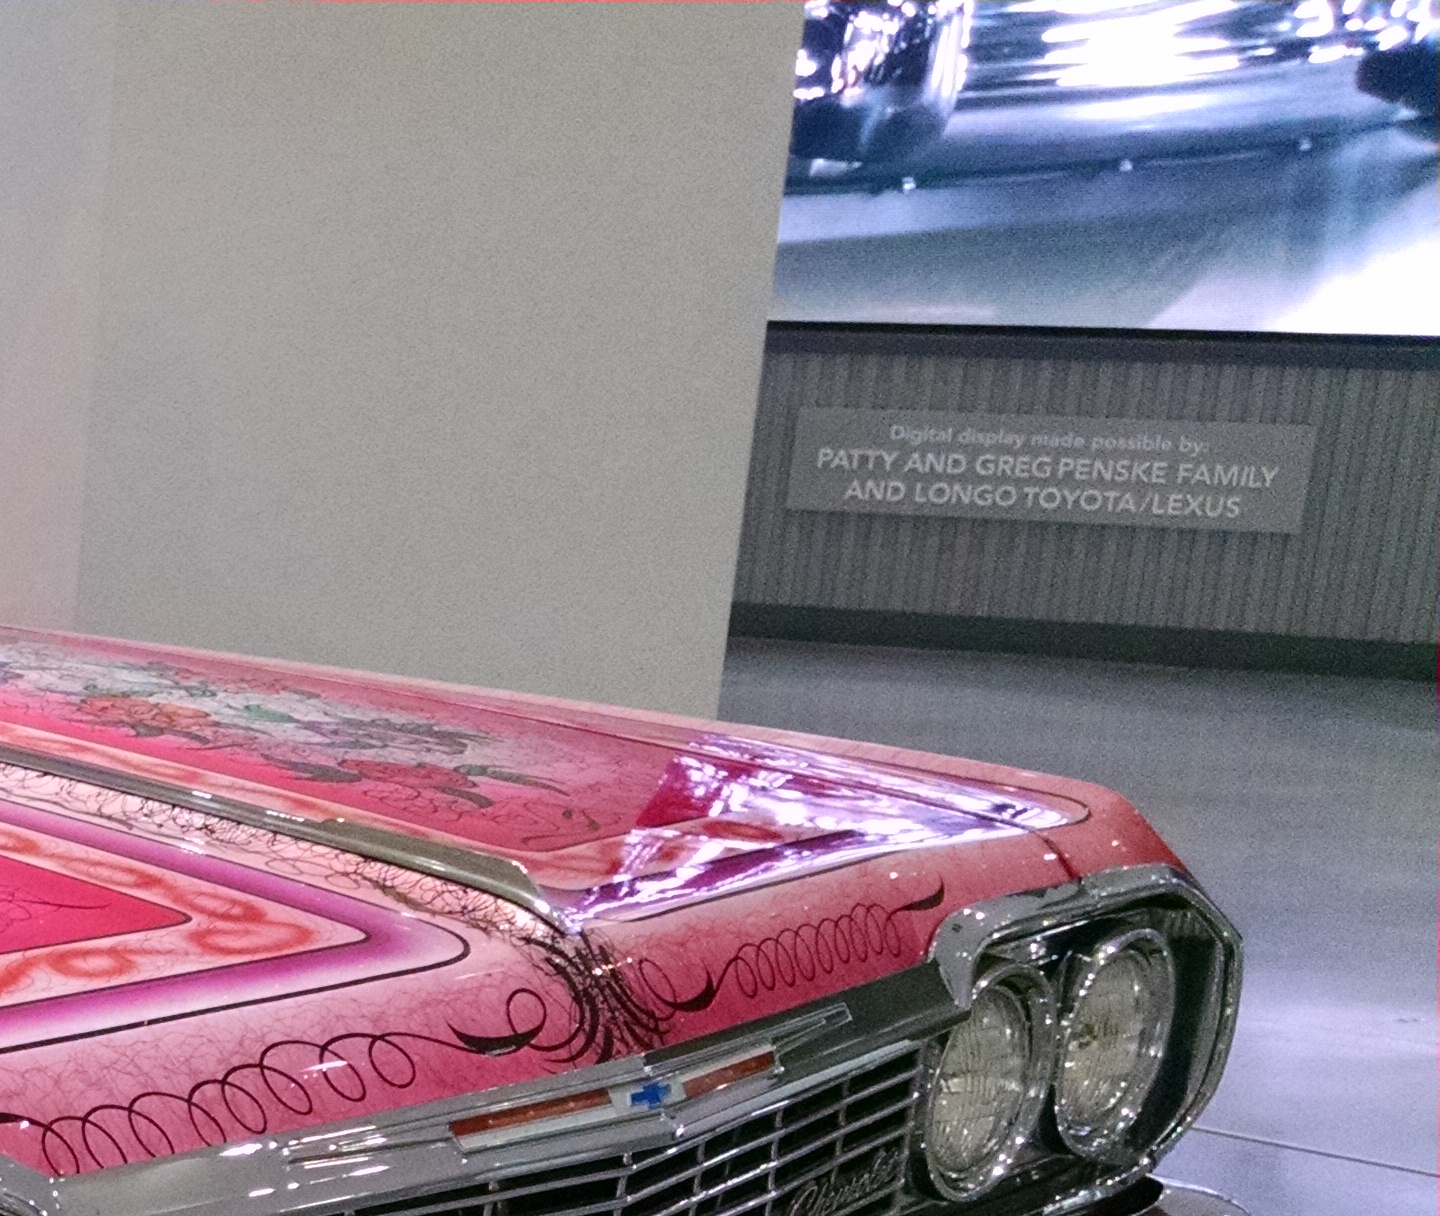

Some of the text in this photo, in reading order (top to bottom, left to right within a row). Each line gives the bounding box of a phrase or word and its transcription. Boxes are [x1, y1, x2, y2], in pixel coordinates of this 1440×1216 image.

[890, 425, 953, 446] Digital
[957, 428, 1024, 450] display
[1031, 432, 1085, 448] made
[1091, 434, 1172, 452] possible
[817, 447, 1280, 489] PATTY AND GREG PENSKE FAMILY
[844, 478, 1242, 518] AND LONGO TOYOTA/LEXUS
